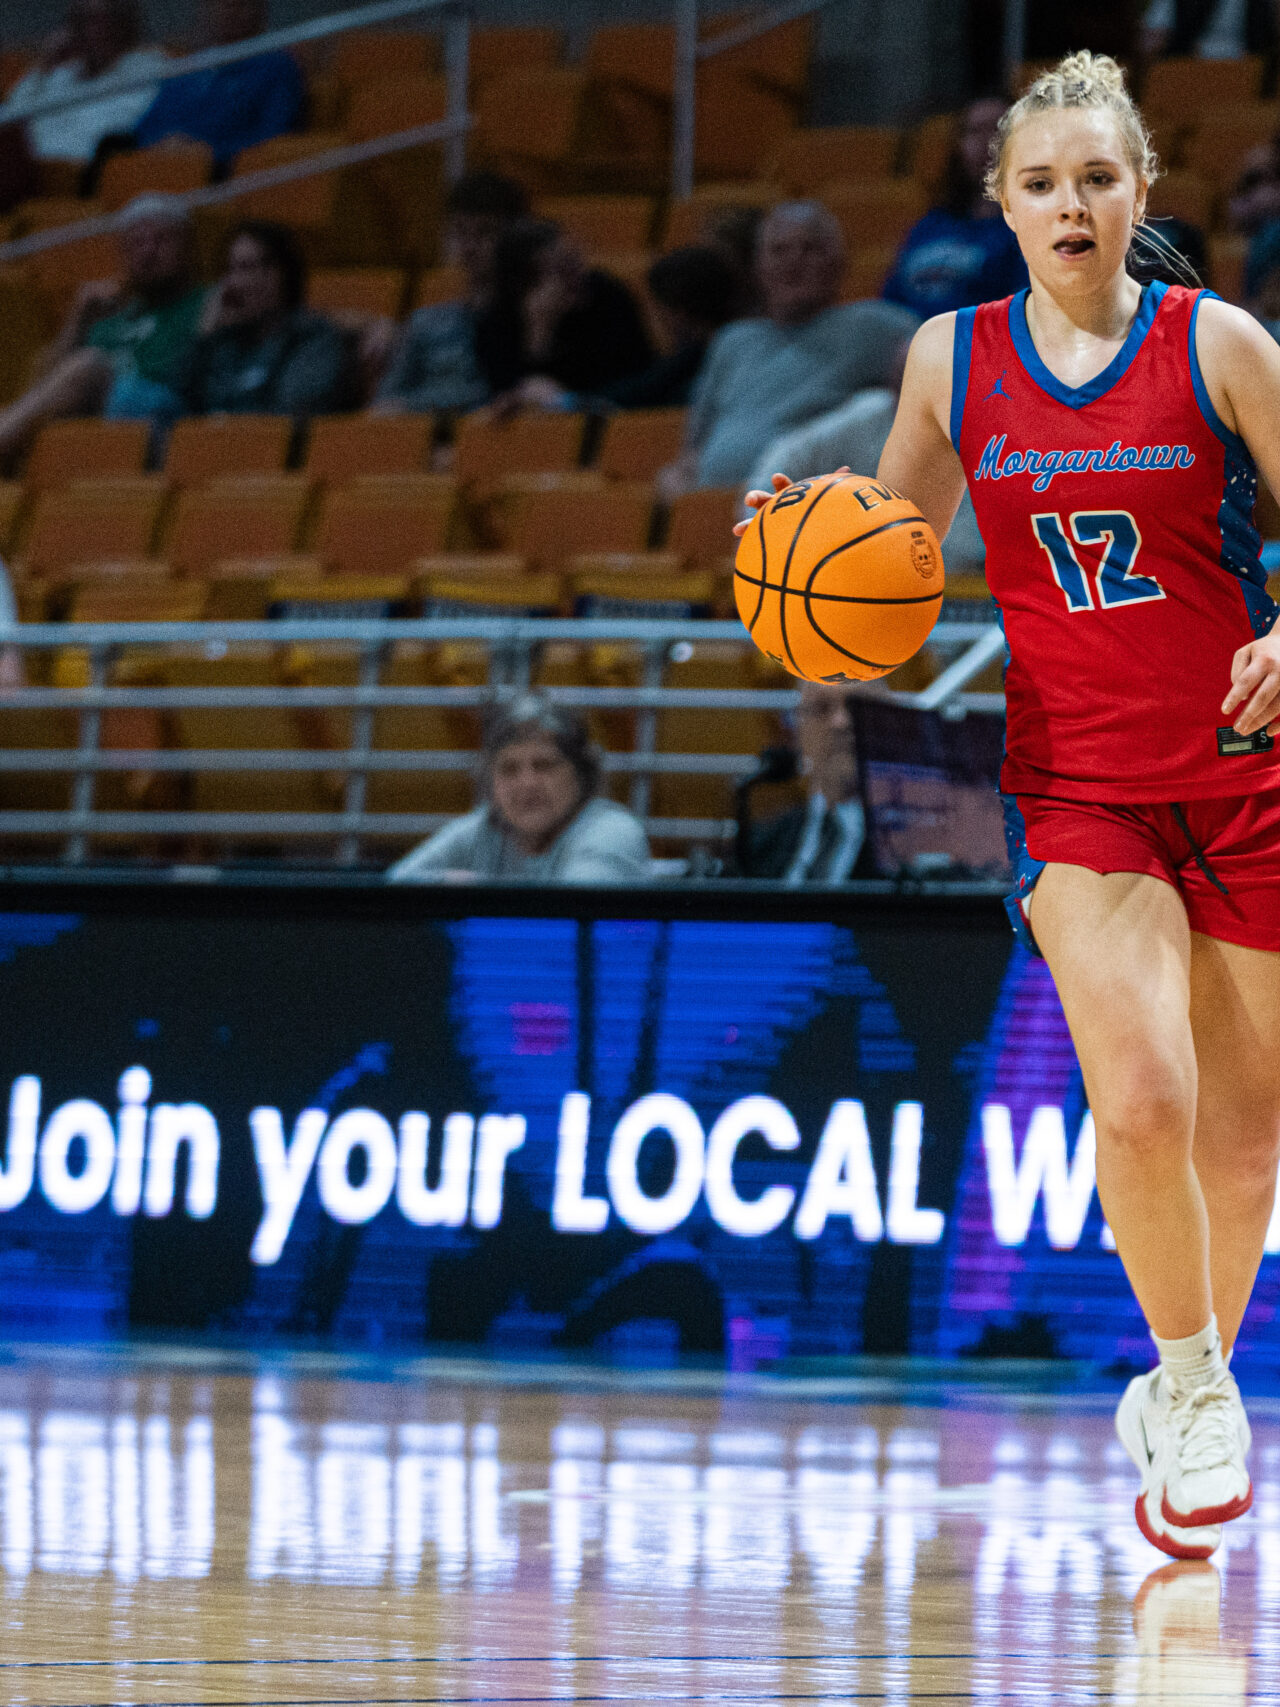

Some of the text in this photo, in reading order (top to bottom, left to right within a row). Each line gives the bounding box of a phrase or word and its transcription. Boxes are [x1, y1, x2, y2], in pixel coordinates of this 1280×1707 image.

[974, 434, 1196, 493] Morgantown
[1031, 510, 1167, 613] 12
[0, 1066, 220, 1218] Join
[250, 1106, 527, 1266] your
[552, 1090, 946, 1246] LOCAL
